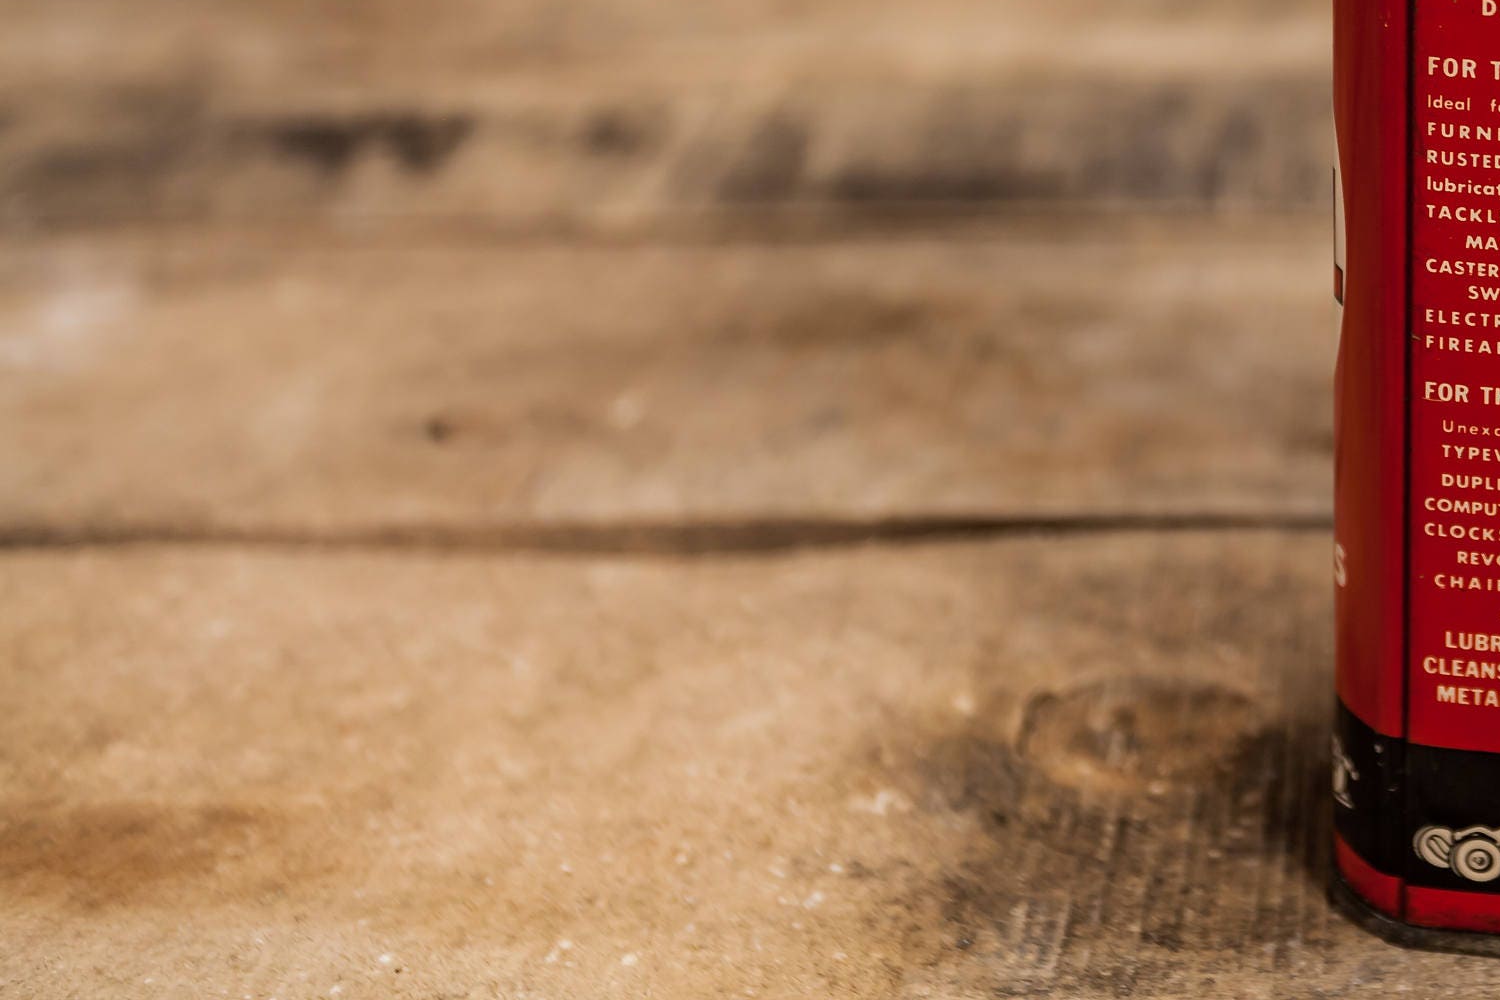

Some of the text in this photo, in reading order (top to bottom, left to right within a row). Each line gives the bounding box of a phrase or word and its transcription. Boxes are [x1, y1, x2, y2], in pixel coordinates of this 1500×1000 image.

[1427, 56, 1477, 79] FOR
[1427, 94, 1471, 111] Ideal
[1424, 381, 1470, 403] FOR
